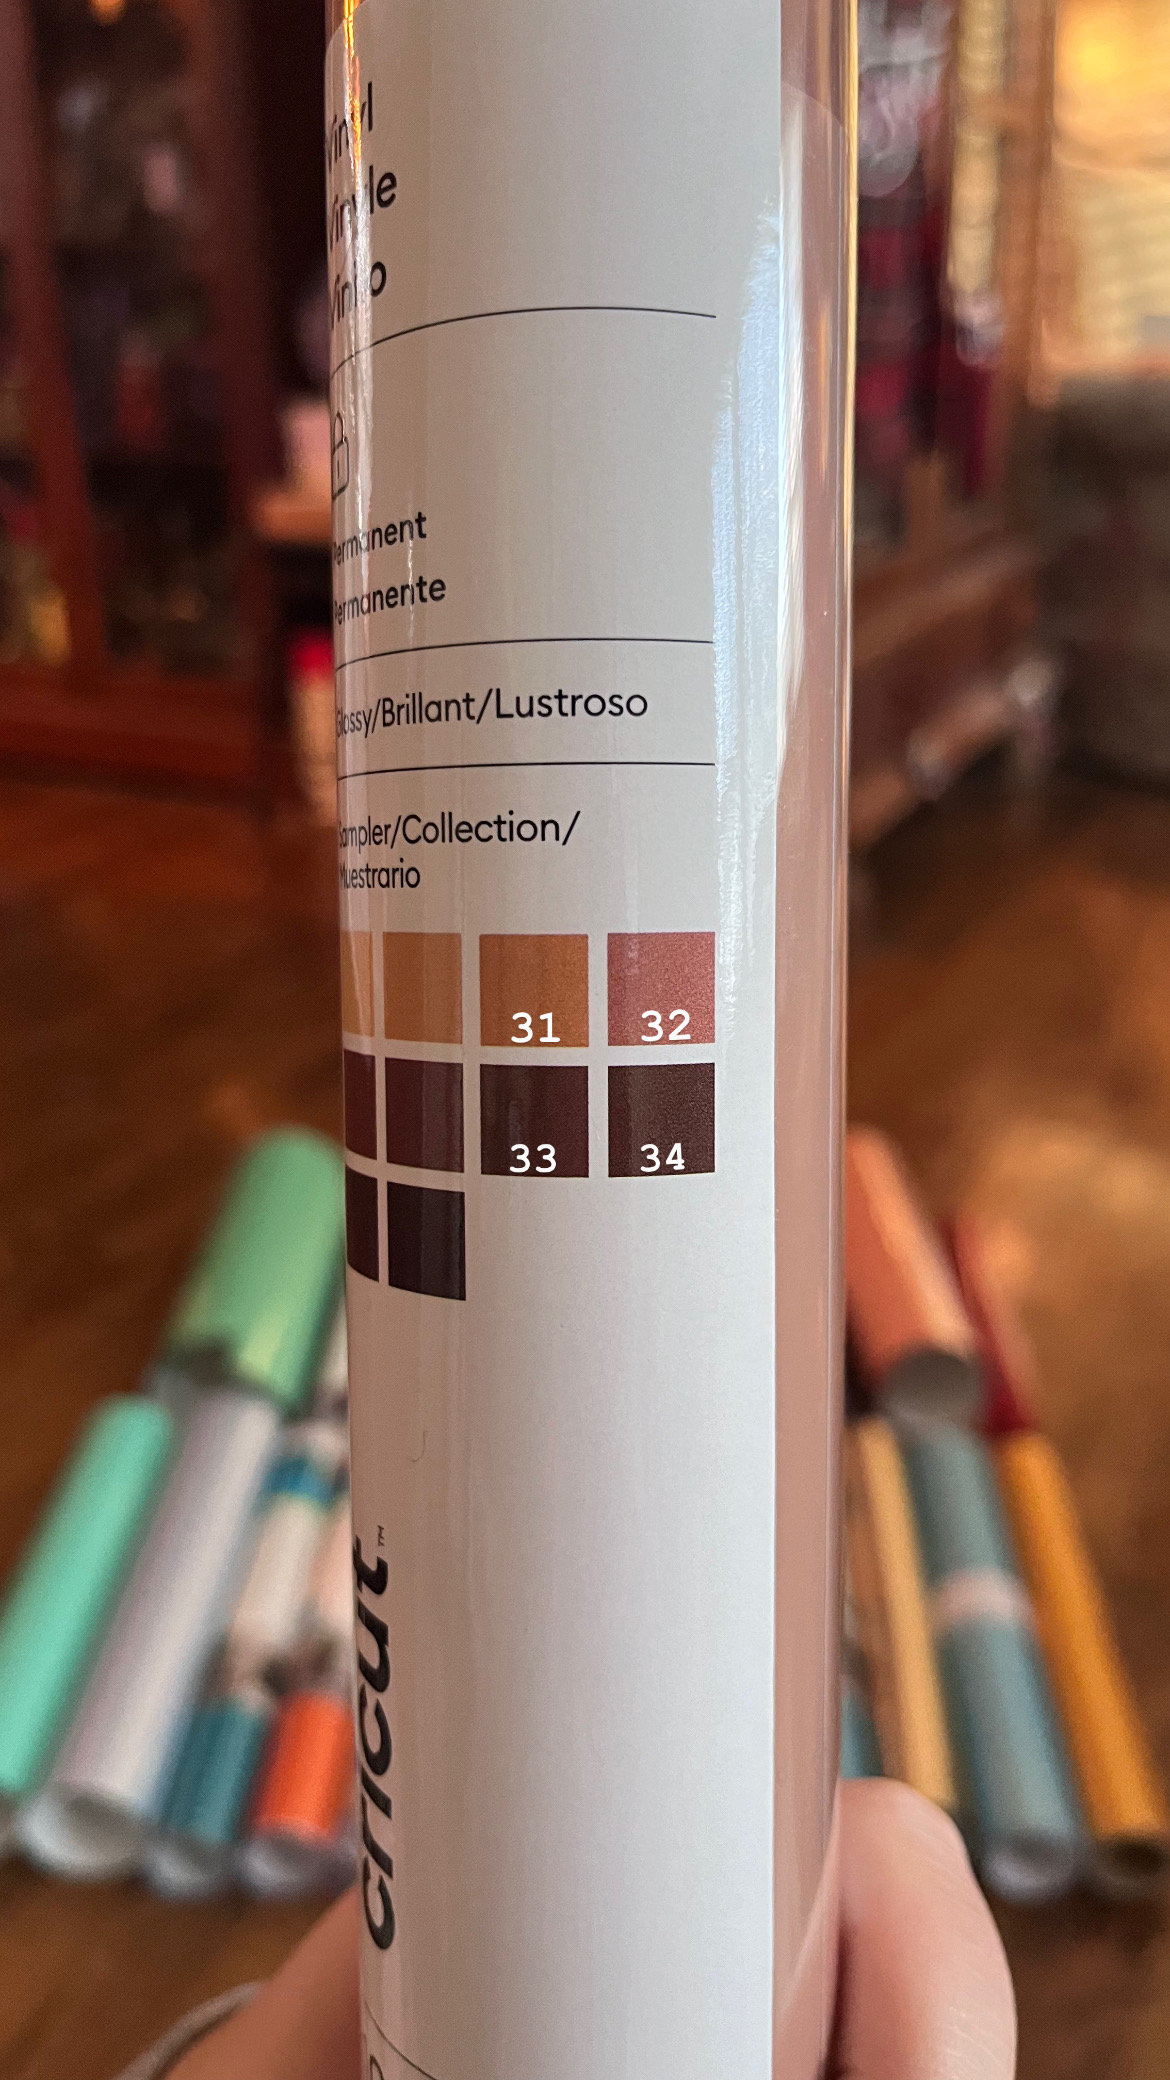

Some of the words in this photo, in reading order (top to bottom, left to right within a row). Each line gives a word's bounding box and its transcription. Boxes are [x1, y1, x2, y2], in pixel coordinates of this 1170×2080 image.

[333, 511, 428, 566] Permanent
[334, 575, 447, 626] Permanente
[336, 688, 649, 738] Glossy/Brillant/Lustroso
[338, 810, 581, 855] Sampler/Collection/
[339, 858, 421, 889] Muestrario
